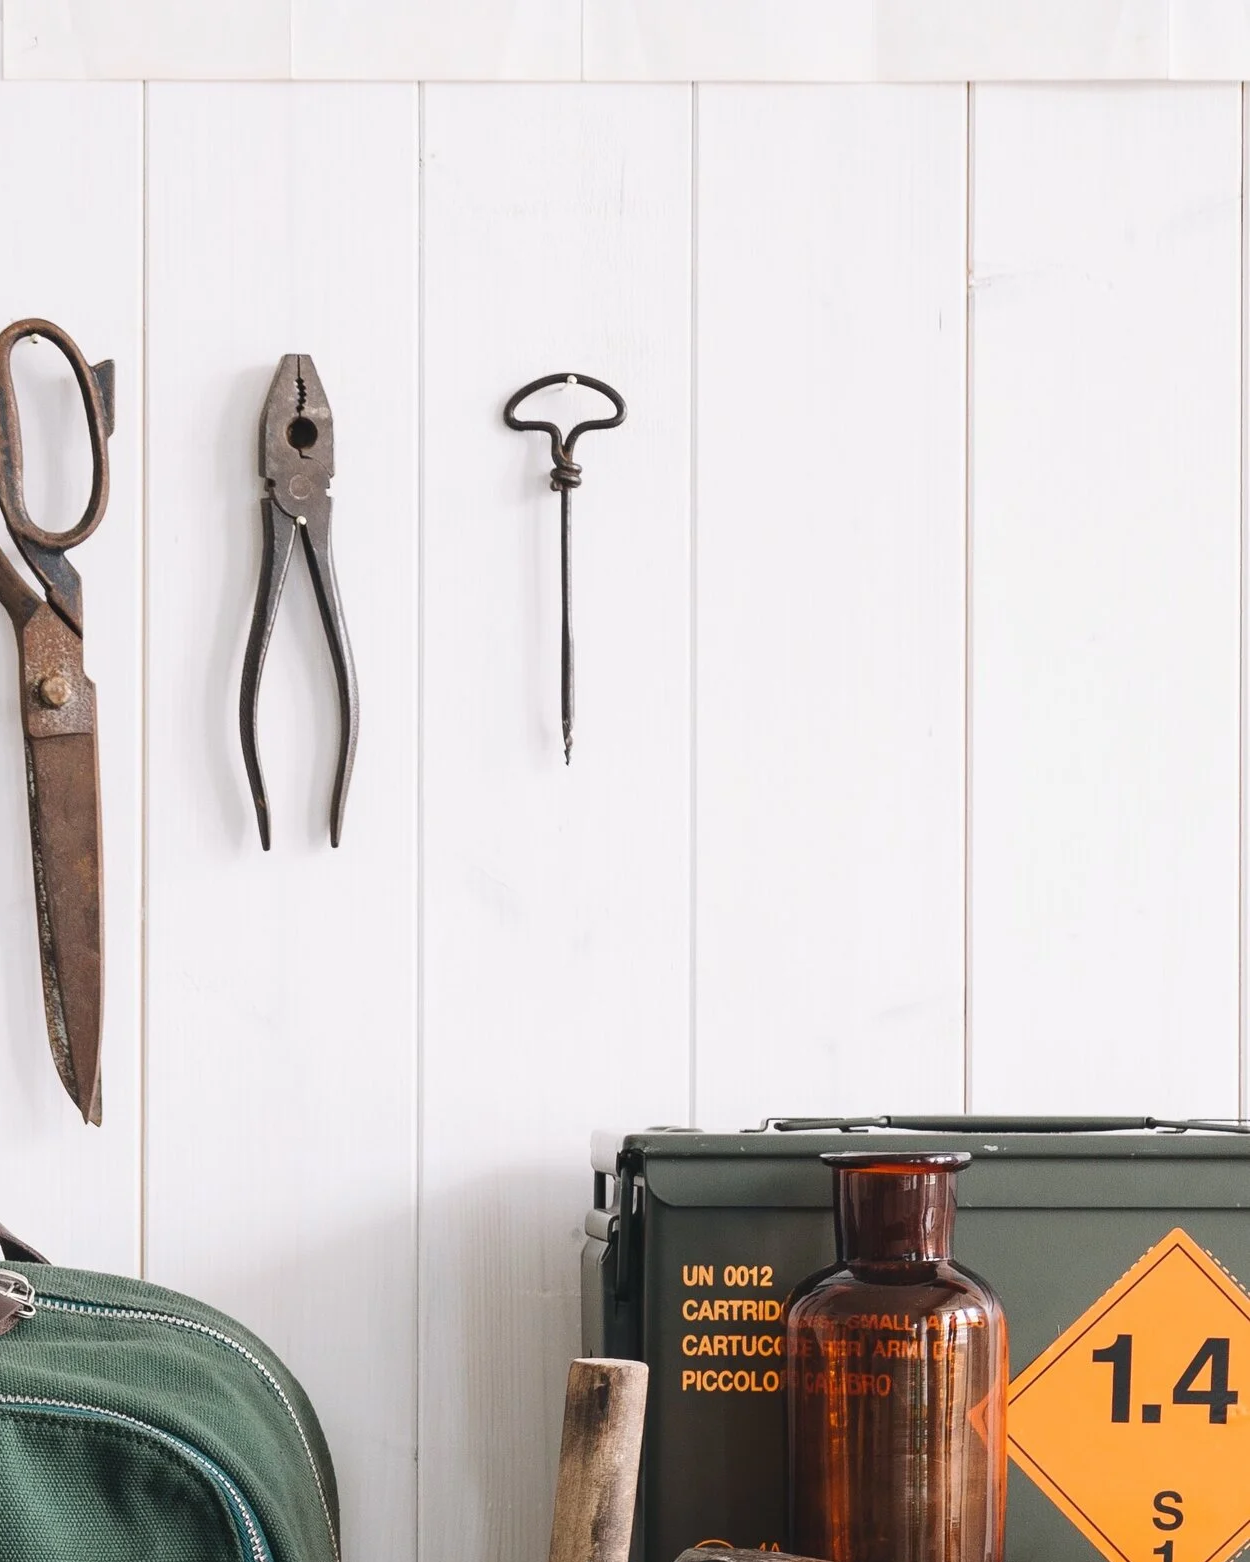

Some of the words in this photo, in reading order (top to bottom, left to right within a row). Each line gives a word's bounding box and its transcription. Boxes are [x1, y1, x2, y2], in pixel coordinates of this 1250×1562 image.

[682, 1265, 714, 1287] UN
[723, 1265, 774, 1287] 0012
[681, 1369, 780, 1392] PICCOLO
[1092, 1334, 1239, 1425] 1.4
[1152, 1491, 1184, 1531] S
